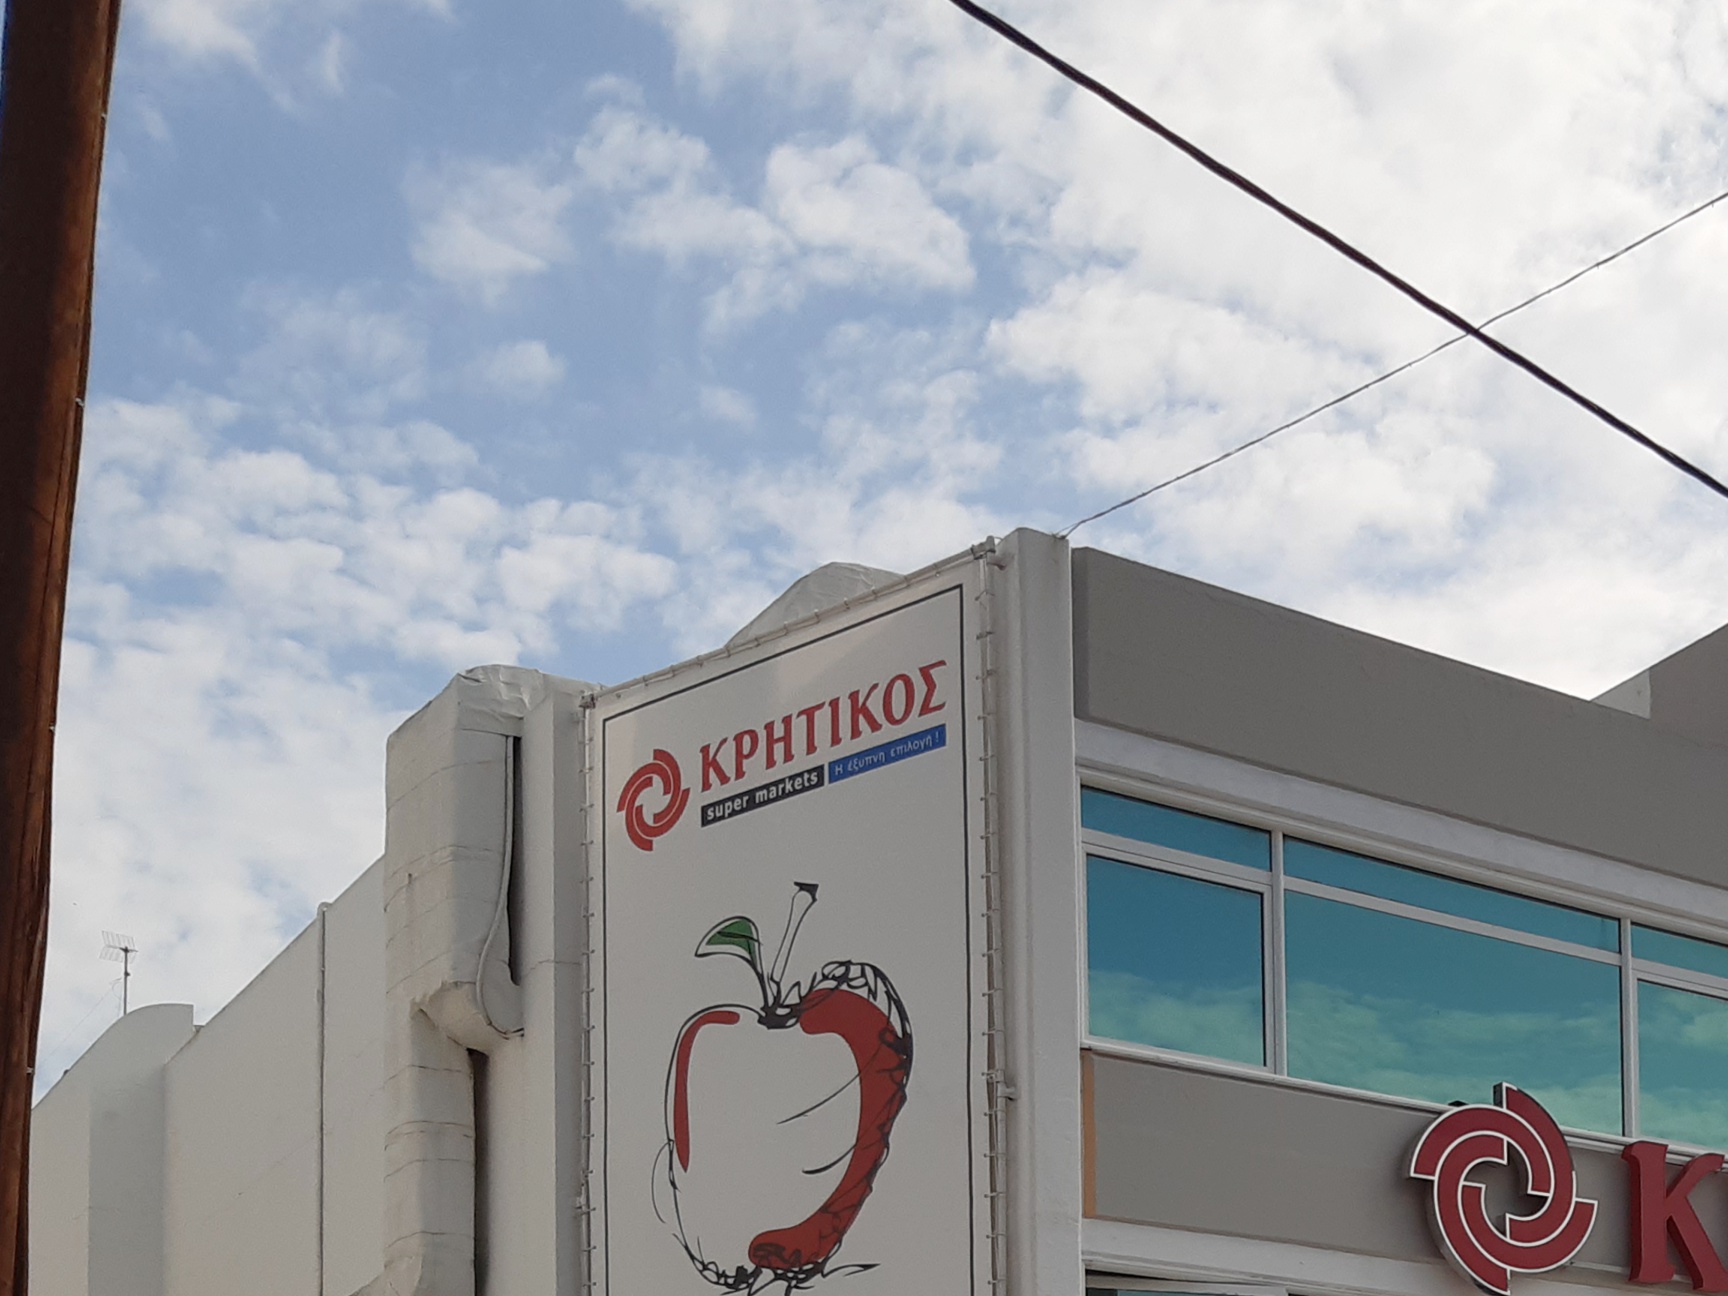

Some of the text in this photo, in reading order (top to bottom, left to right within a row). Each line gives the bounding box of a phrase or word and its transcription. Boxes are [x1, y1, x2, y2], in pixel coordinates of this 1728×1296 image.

[700, 659, 948, 793] ΚΡΗΤΙΚΟΣ
[834, 763, 844, 777] Η
[847, 748, 886, 773] έξυπνη
[706, 768, 819, 823] super markets
